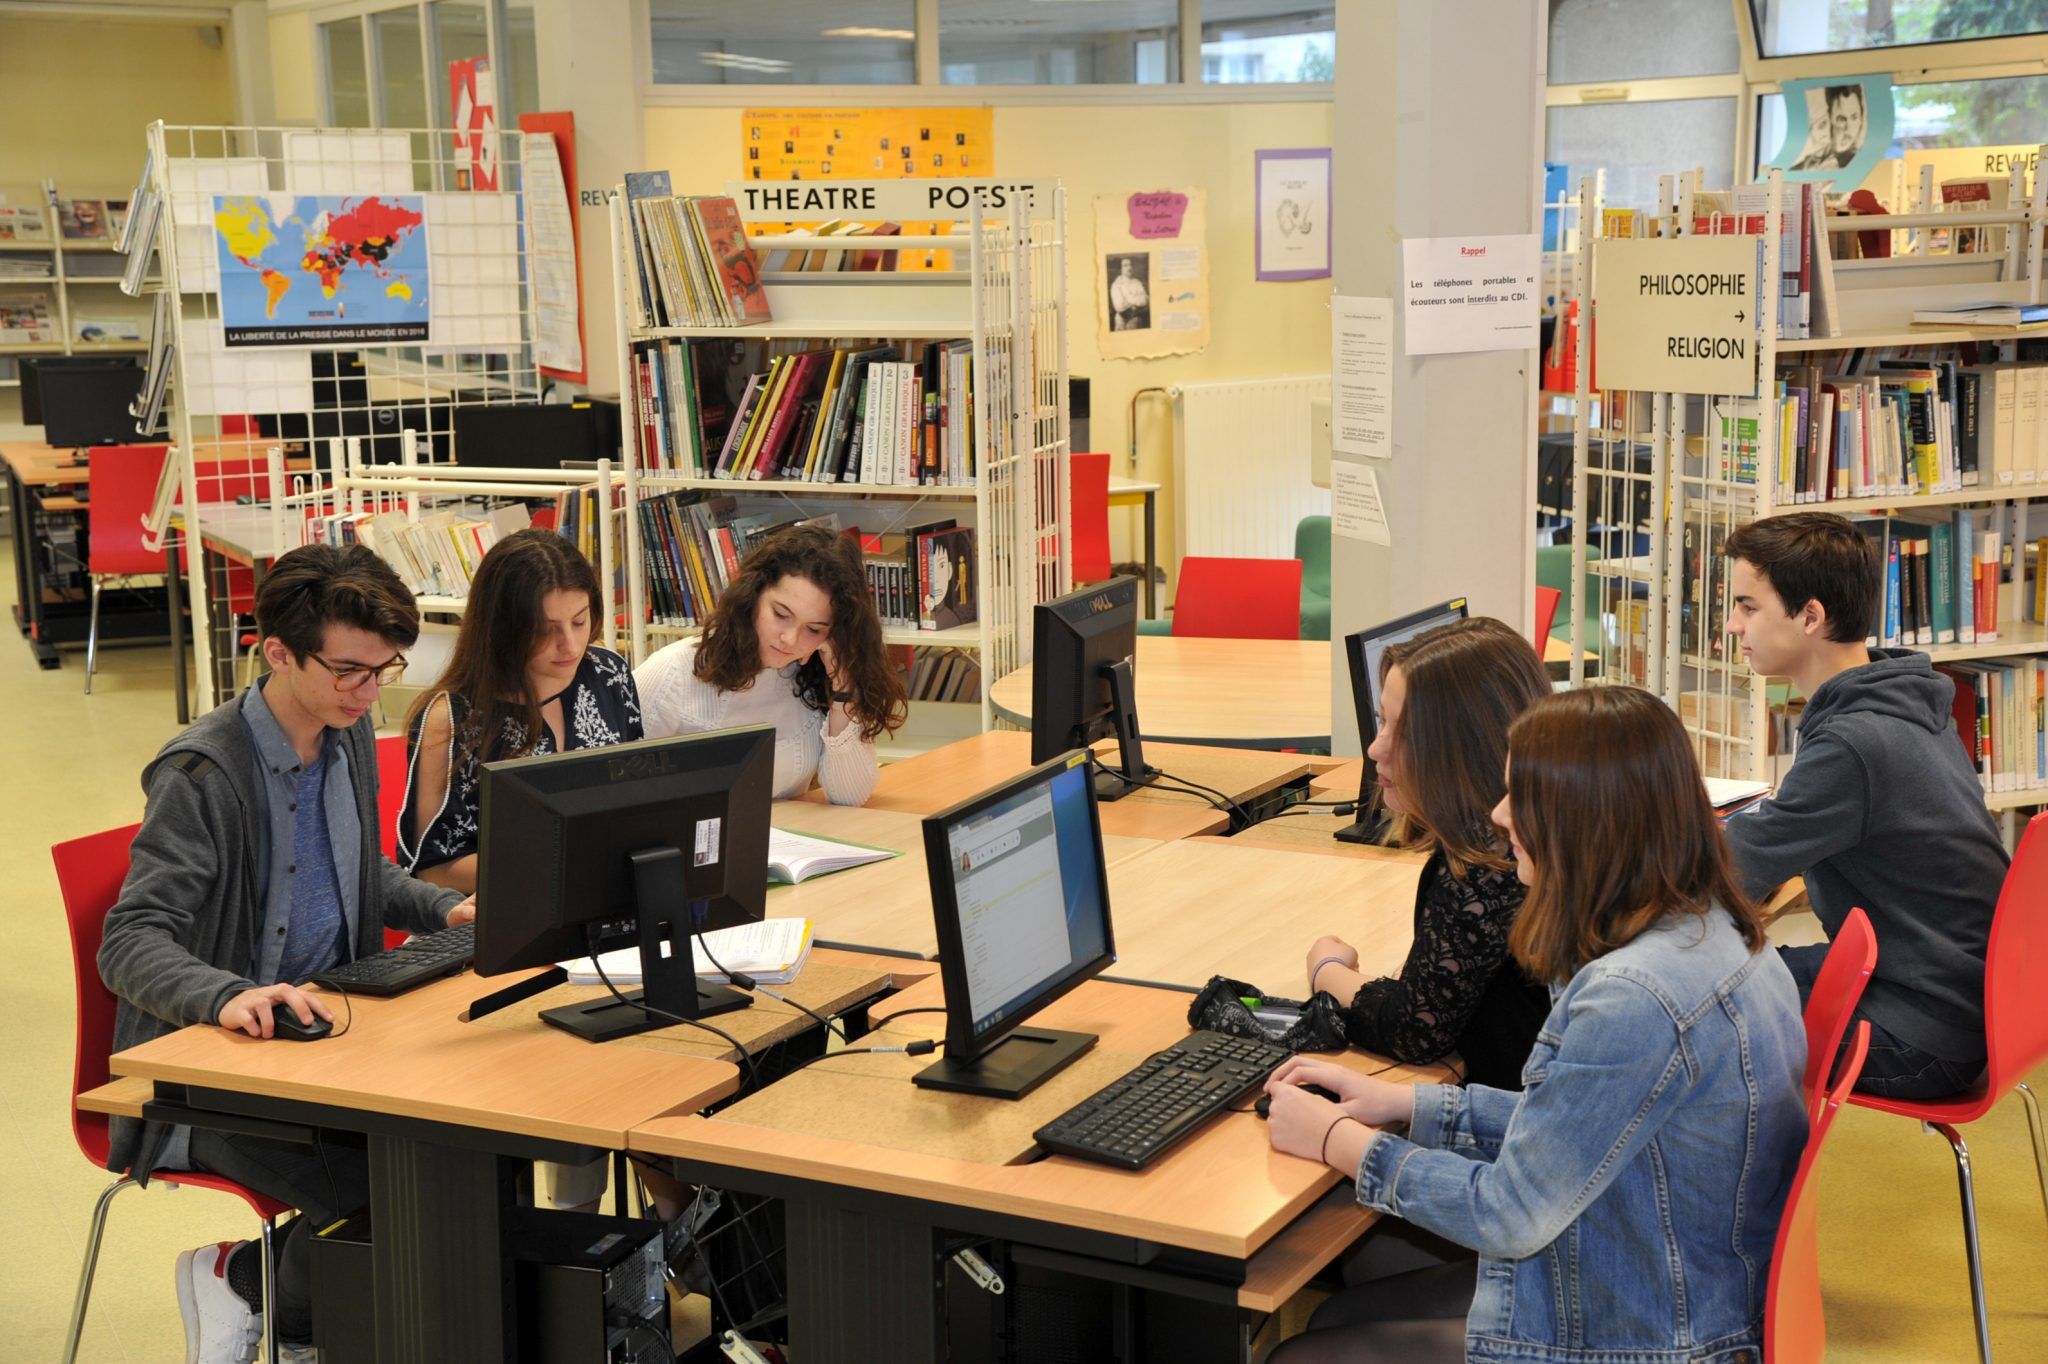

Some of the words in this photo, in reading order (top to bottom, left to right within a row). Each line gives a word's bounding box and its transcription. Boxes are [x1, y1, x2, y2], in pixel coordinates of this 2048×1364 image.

[581, 190, 618, 206] REV
[744, 187, 876, 210] THEATRE
[928, 185, 1034, 209] POESE
[1461, 246, 1486, 257] Rappel
[1410, 280, 1423, 288] Les
[1433, 278, 1472, 288] téléphones
[1482, 276, 1516, 286] portables
[1640, 274, 1746, 296] PHILOSOPHIE
[1410, 298, 1446, 306] écouteurs
[1467, 294, 1498, 304] interdits
[228, 332, 241, 341] LA
[241, 331, 274, 340] LIBERTÉ
[276, 332, 286, 340] DE
[288, 331, 299, 339] LA
[300, 330, 332, 339] PRESSE
[332, 330, 355, 338] DANS
[356, 330, 366, 338] LE
[367, 328, 396, 338] MONDE
[398, 328, 408, 336] EN
[1668, 337, 1744, 359] RELIGION
[870, 380, 878, 426] GRAPHIQUE
[902, 380, 910, 428] GRAPHIQUE
[1088, 593, 1113, 614] DELL
[608, 752, 677, 781] DELL
